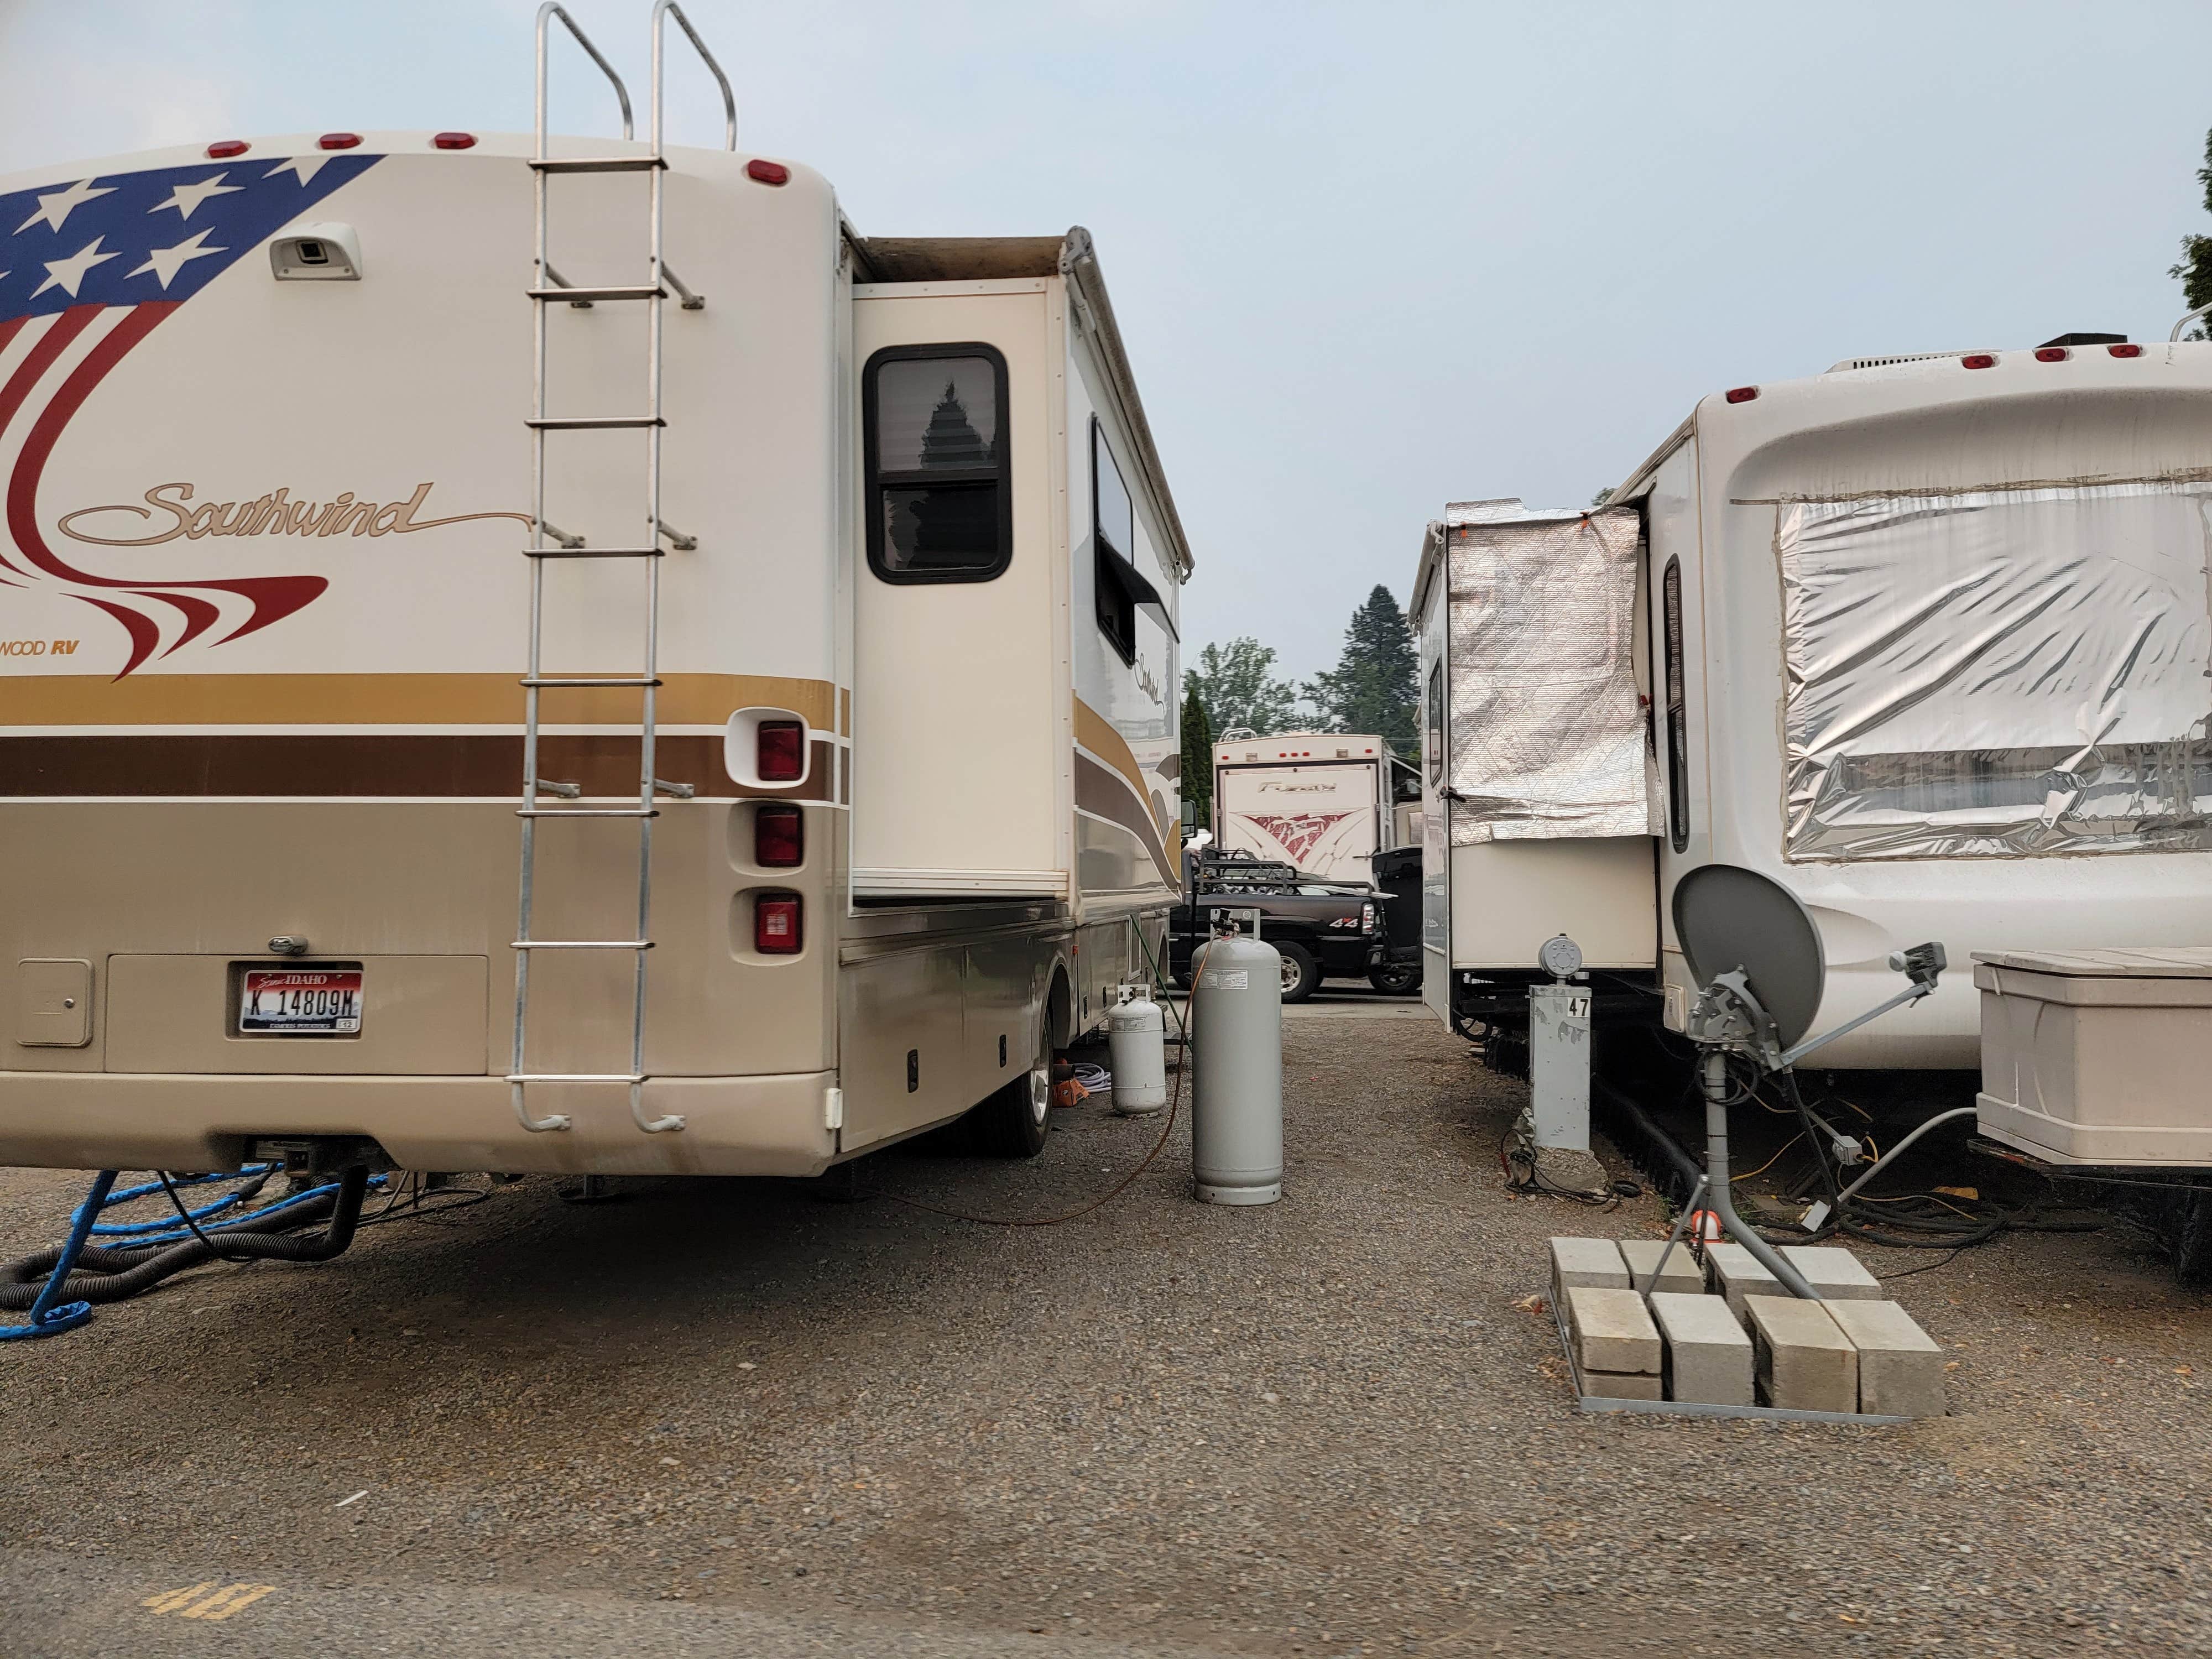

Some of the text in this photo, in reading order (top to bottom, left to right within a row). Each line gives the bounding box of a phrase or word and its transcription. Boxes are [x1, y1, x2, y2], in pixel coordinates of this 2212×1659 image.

[58, 482, 533, 546] Southwind
[50, 640, 80, 655] RV
[286, 975, 327, 984] IDAHO
[251, 989, 263, 1016] K
[1569, 998, 1589, 1016] 47
